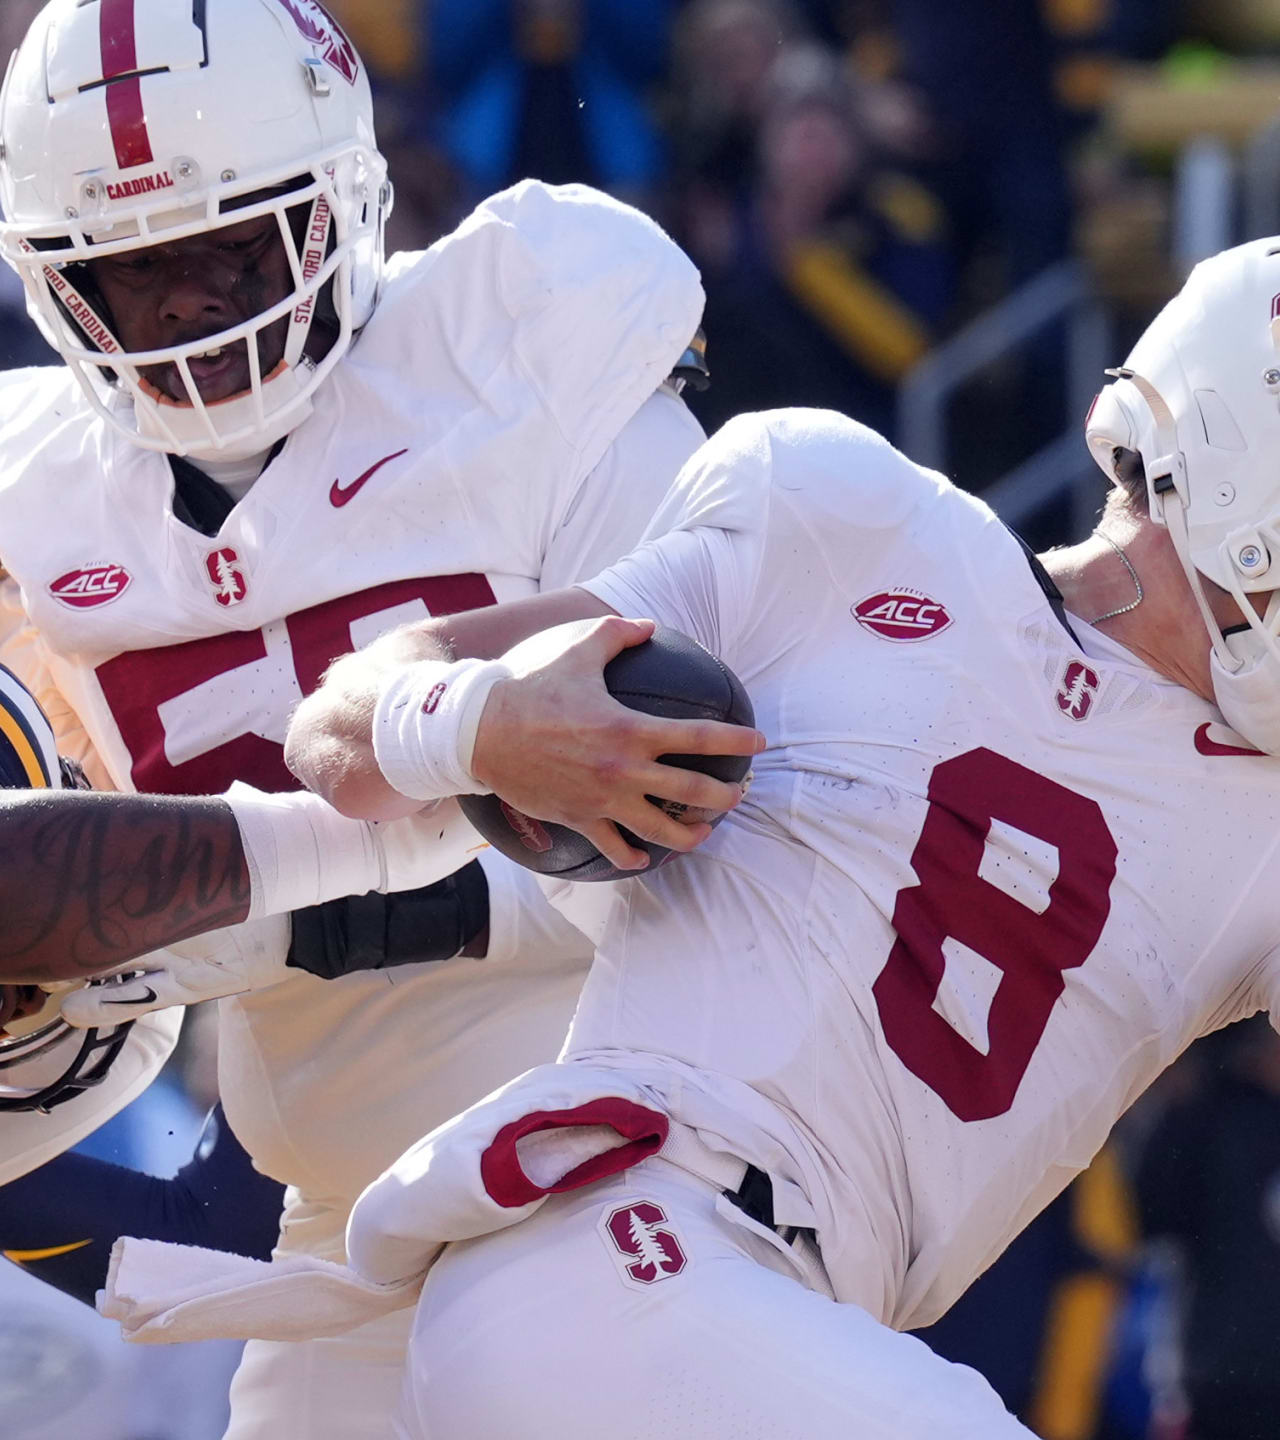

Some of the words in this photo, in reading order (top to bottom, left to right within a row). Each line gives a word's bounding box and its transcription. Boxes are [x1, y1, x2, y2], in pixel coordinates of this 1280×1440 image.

[106, 171, 174, 200] CARDINAL
[294, 249, 323, 324] STAORD
[59, 567, 123, 592] ACC
[865, 600, 942, 625] ACC
[872, 746, 1118, 1123] 8
